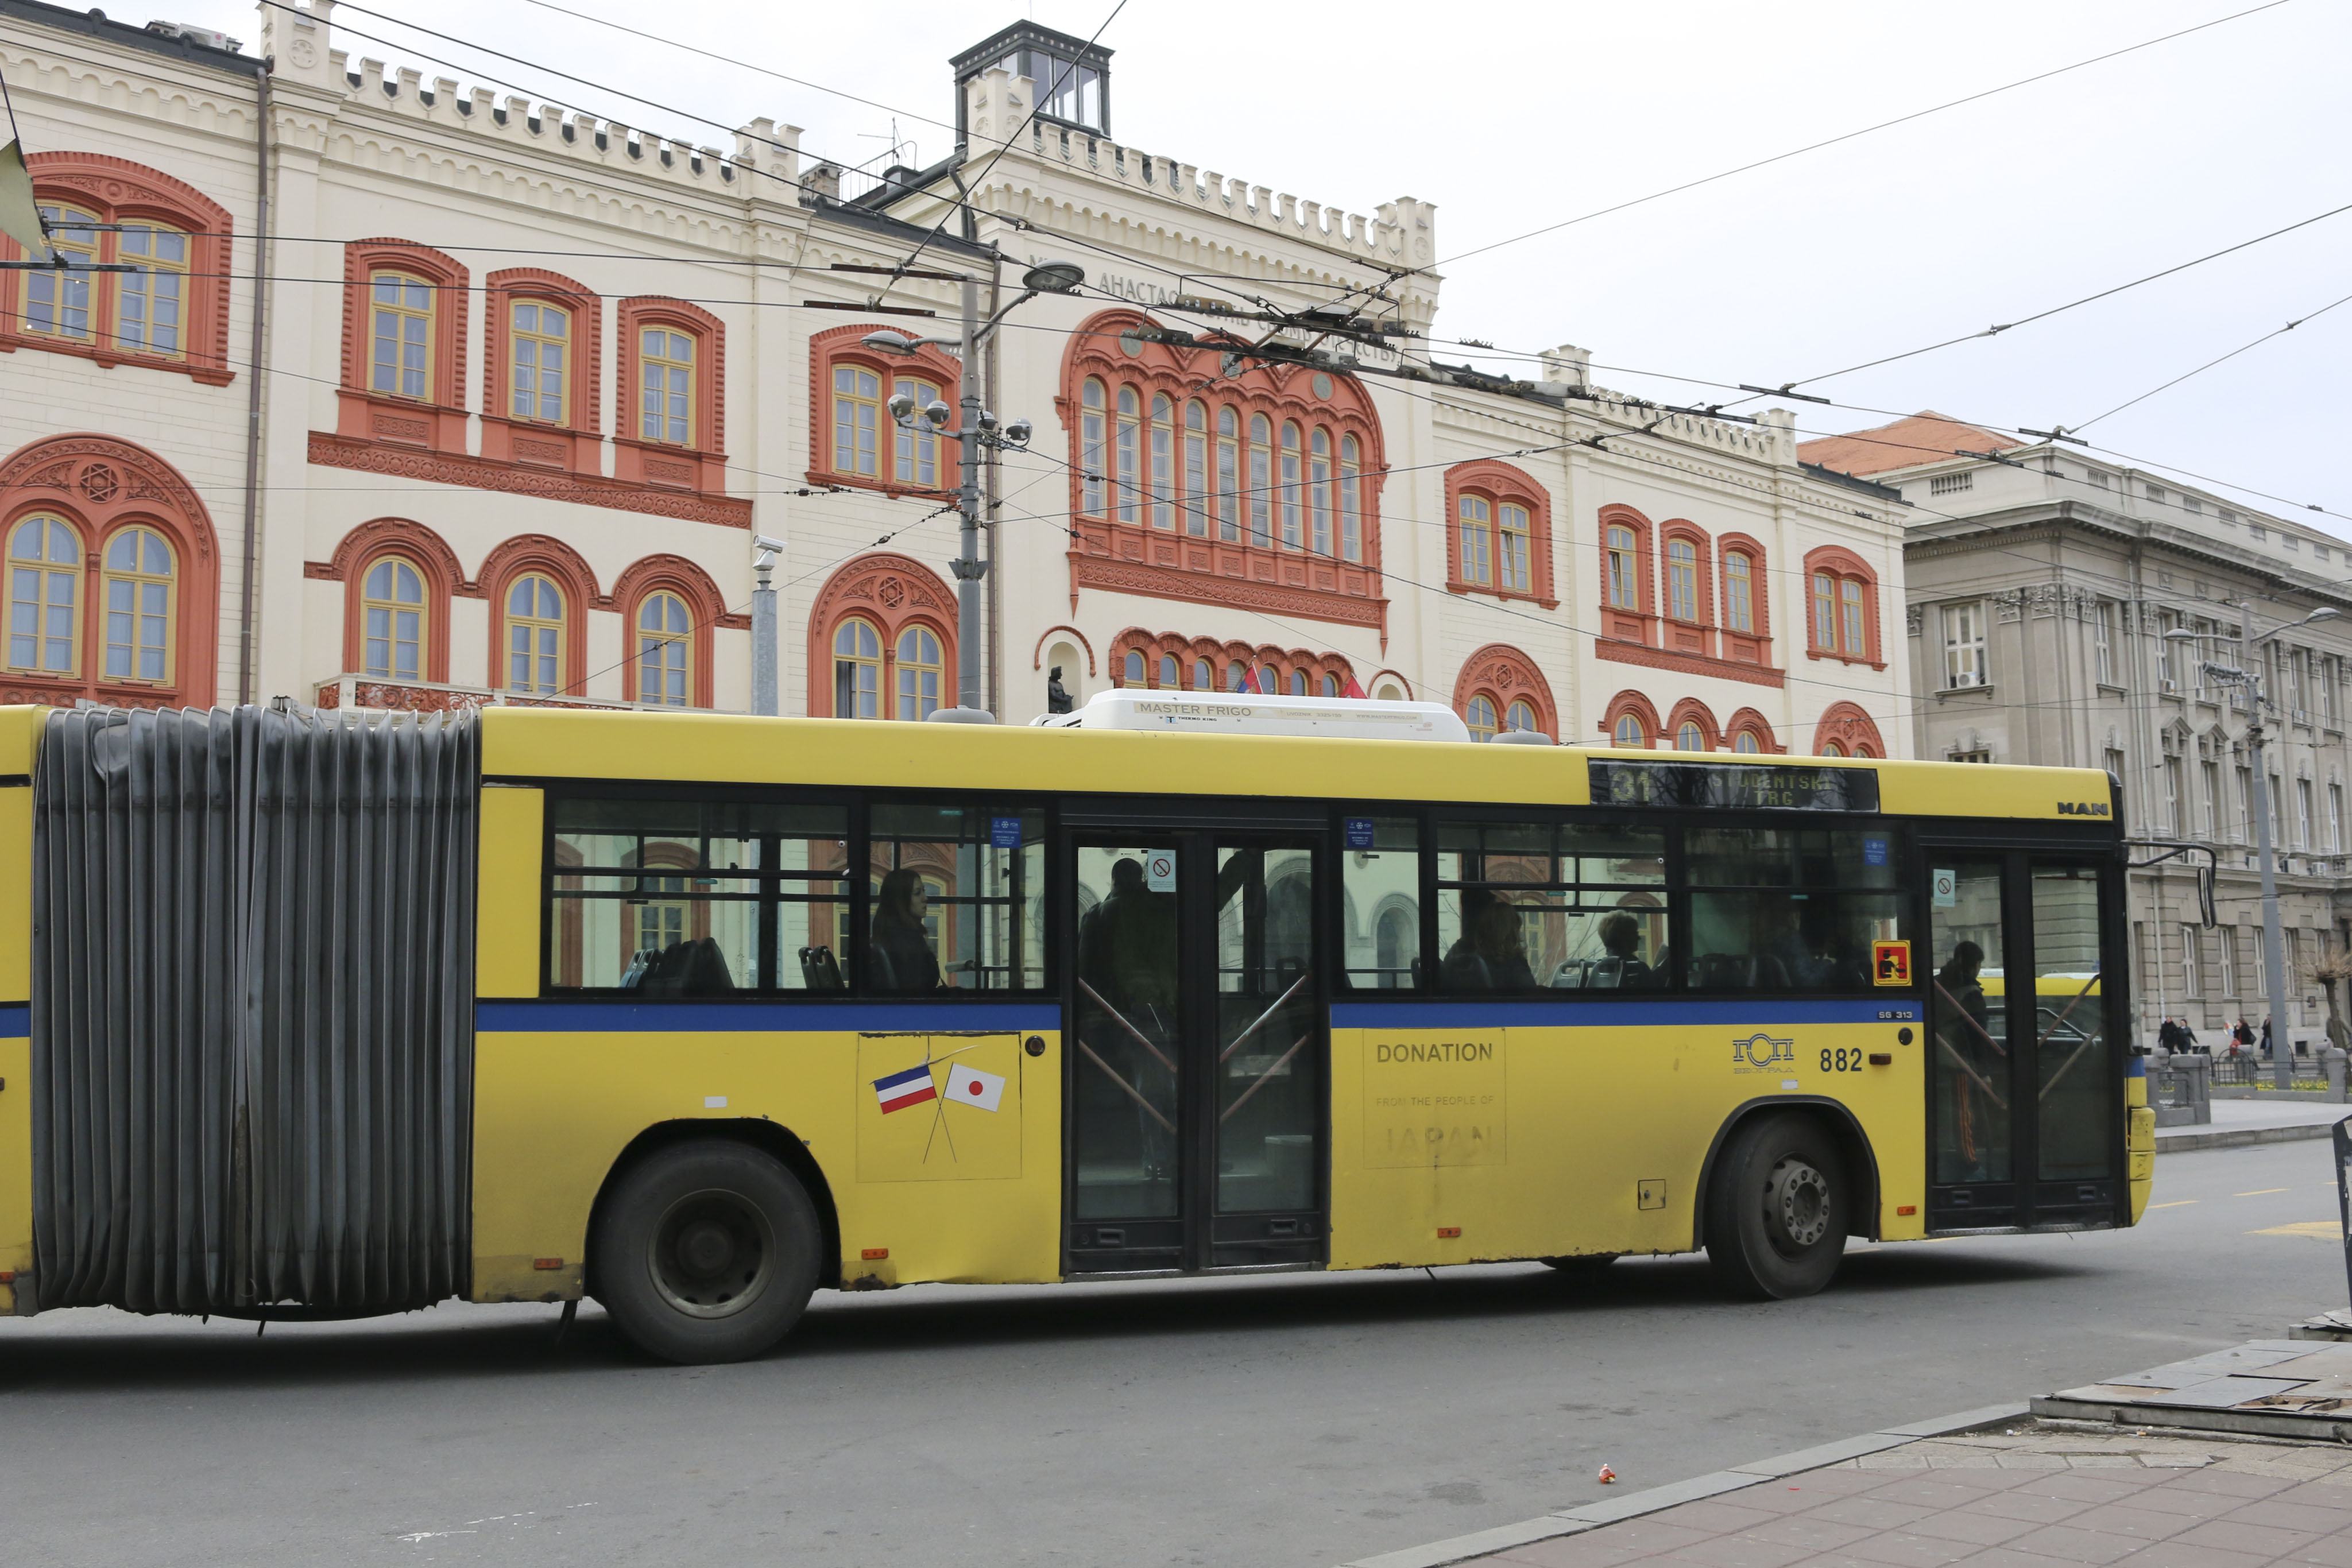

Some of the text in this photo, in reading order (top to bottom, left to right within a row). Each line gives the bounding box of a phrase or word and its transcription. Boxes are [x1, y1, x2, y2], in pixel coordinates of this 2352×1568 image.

[1140, 703, 1251, 717] MASTER FRIGO
[1612, 771, 1649, 802] 31
[1712, 773, 1831, 790] STUDENTSKI
[1754, 790, 1793, 805] TRG
[2057, 802, 2108, 816] MAN
[1377, 1043, 1492, 1063] DONATION
[1820, 1048, 1862, 1072] 882
[1376, 1095, 1494, 1106] FROM THE PEOPLE OF
